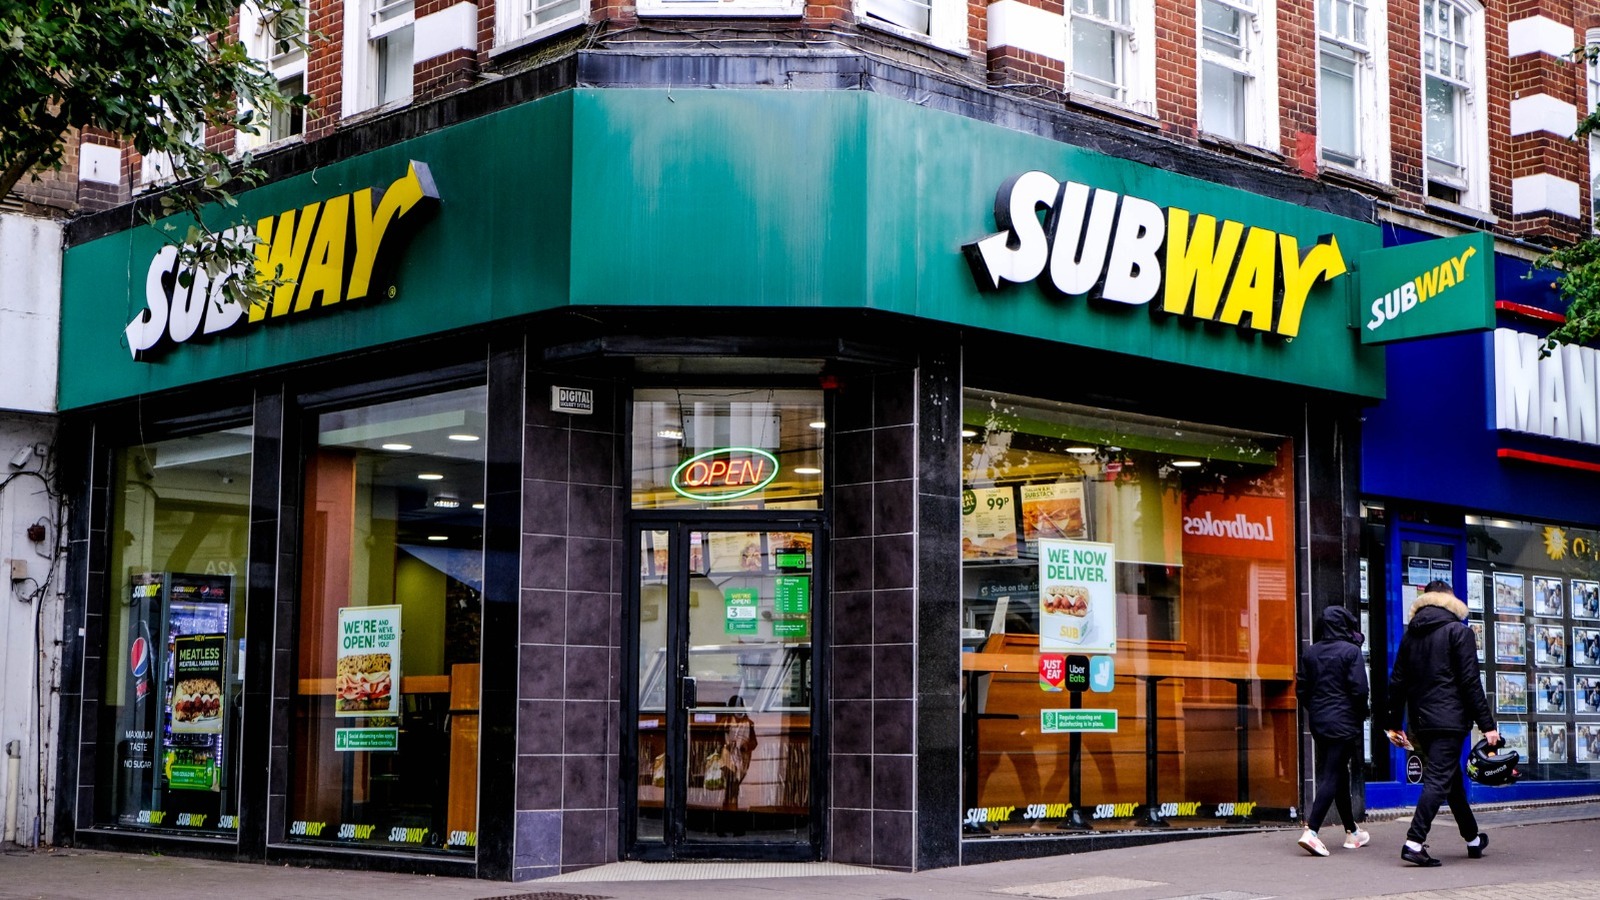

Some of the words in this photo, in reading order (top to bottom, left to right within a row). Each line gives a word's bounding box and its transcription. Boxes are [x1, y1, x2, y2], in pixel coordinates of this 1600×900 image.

[125, 160, 432, 361] SUBWAY
[978, 170, 1347, 338] SUBWAY
[1367, 246, 1476, 331] SUBWAY
[1494, 328, 1600, 445] MAN
[560, 389, 590, 403] DIGITAL
[684, 459, 764, 487] OPEN
[1047, 548, 1069, 563] WE
[1074, 550, 1107, 566] NOW
[1047, 565, 1107, 582] DELIVER.
[133, 584, 161, 598] SUBWAY
[343, 620, 377, 634] WE'RE
[1060, 626, 1079, 639] SUB
[343, 635, 375, 650] OPEN!
[180, 648, 220, 660] MEATLESS
[1043, 660, 1062, 670] JUST
[1069, 664, 1085, 674] Uber
[1047, 670, 1062, 680] EAT
[1069, 674, 1085, 683] Eats
[125, 730, 153, 739] MAXIMUM
[130, 742, 148, 751] TASTE
[124, 759, 133, 768] NO
[133, 760, 152, 769] SUGAR
[137, 810, 166, 824] SUBWAY
[176, 813, 207, 827] SUBWAY
[963, 805, 1015, 824] SUBWAY
[1023, 803, 1073, 820] SUBWAY
[1093, 802, 1139, 819] SUBWAY
[1158, 802, 1201, 817] SUBWAY
[1215, 802, 1257, 817] SUBWAY
[290, 821, 326, 836] SUBWAY
[337, 823, 375, 839] SUBWAY
[388, 827, 428, 843] SUBWAY
